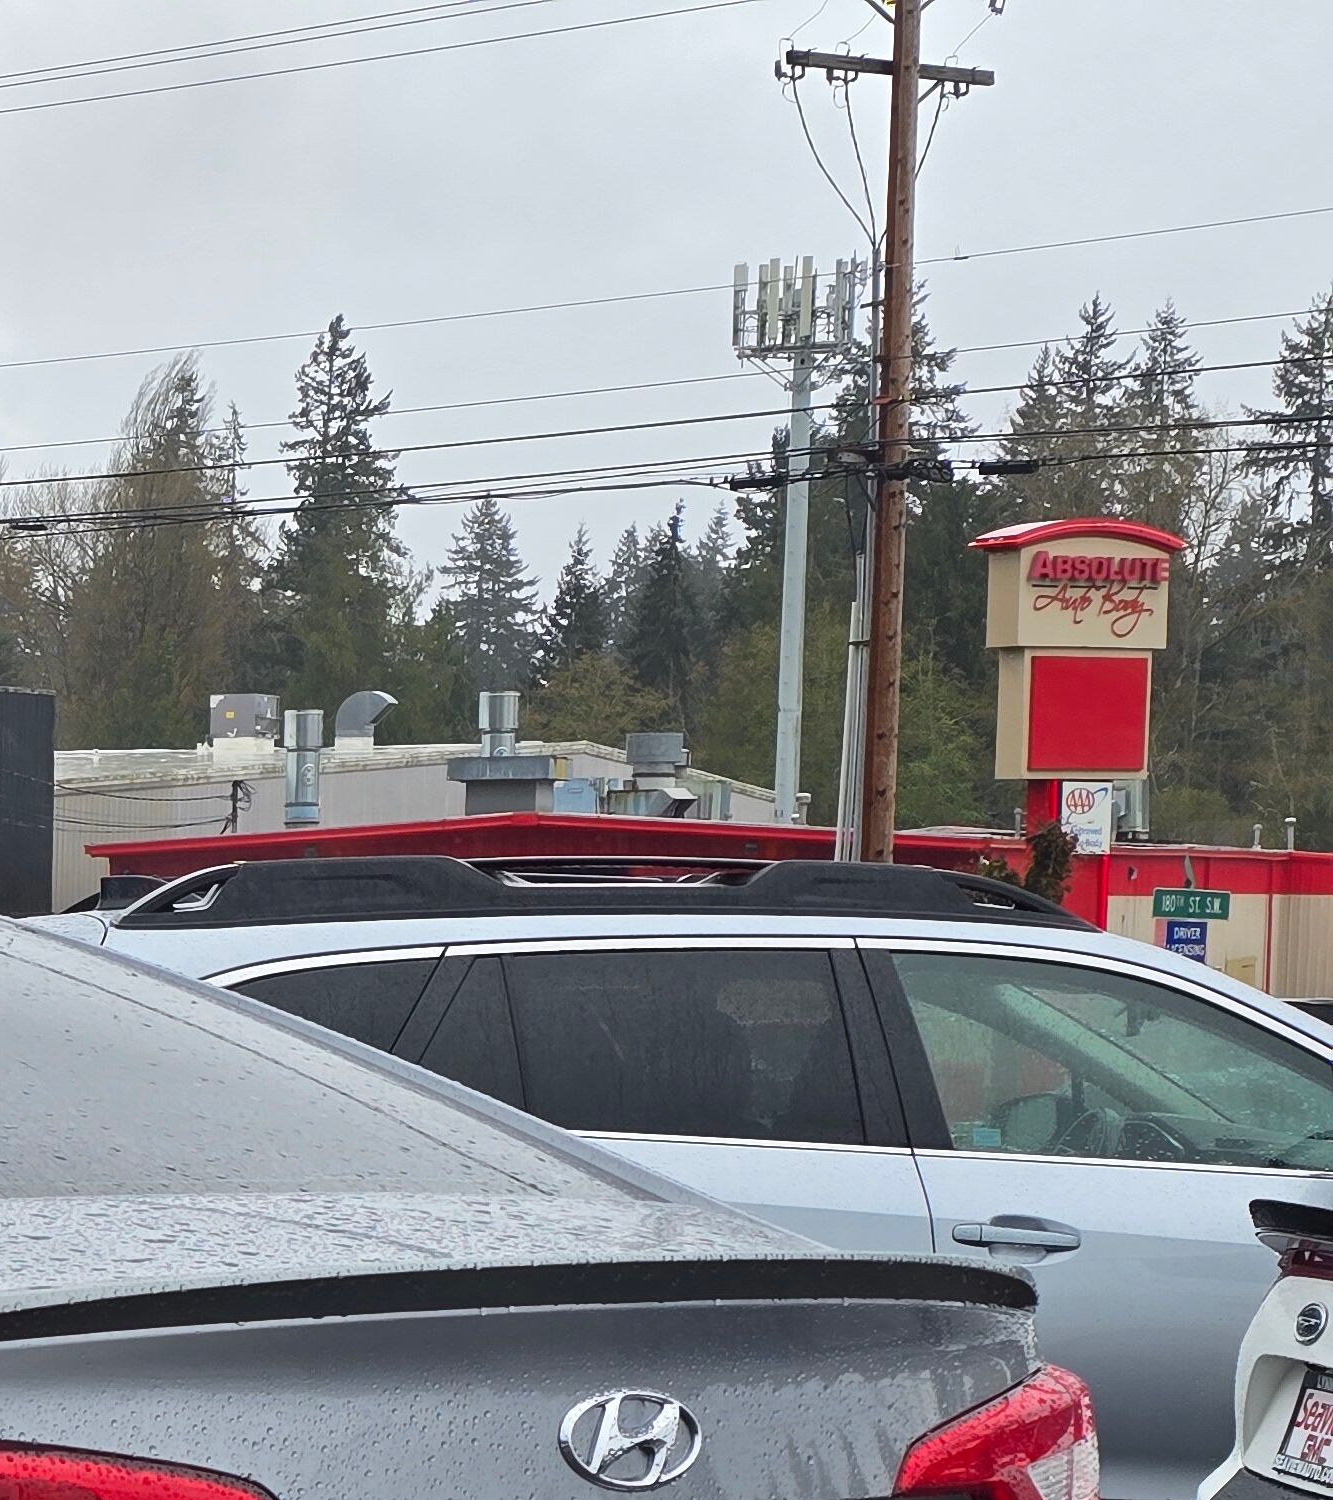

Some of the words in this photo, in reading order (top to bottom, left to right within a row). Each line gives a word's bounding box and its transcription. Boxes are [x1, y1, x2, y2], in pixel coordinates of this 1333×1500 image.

[1028, 550, 1170, 582] ABSOLUTE
[1033, 583, 1101, 624] Auto
[1097, 581, 1154, 638] Body
[1069, 789, 1092, 813] AAA
[1174, 927, 1201, 939] DRIVER
[1301, 1434, 1332, 1465] GMC
